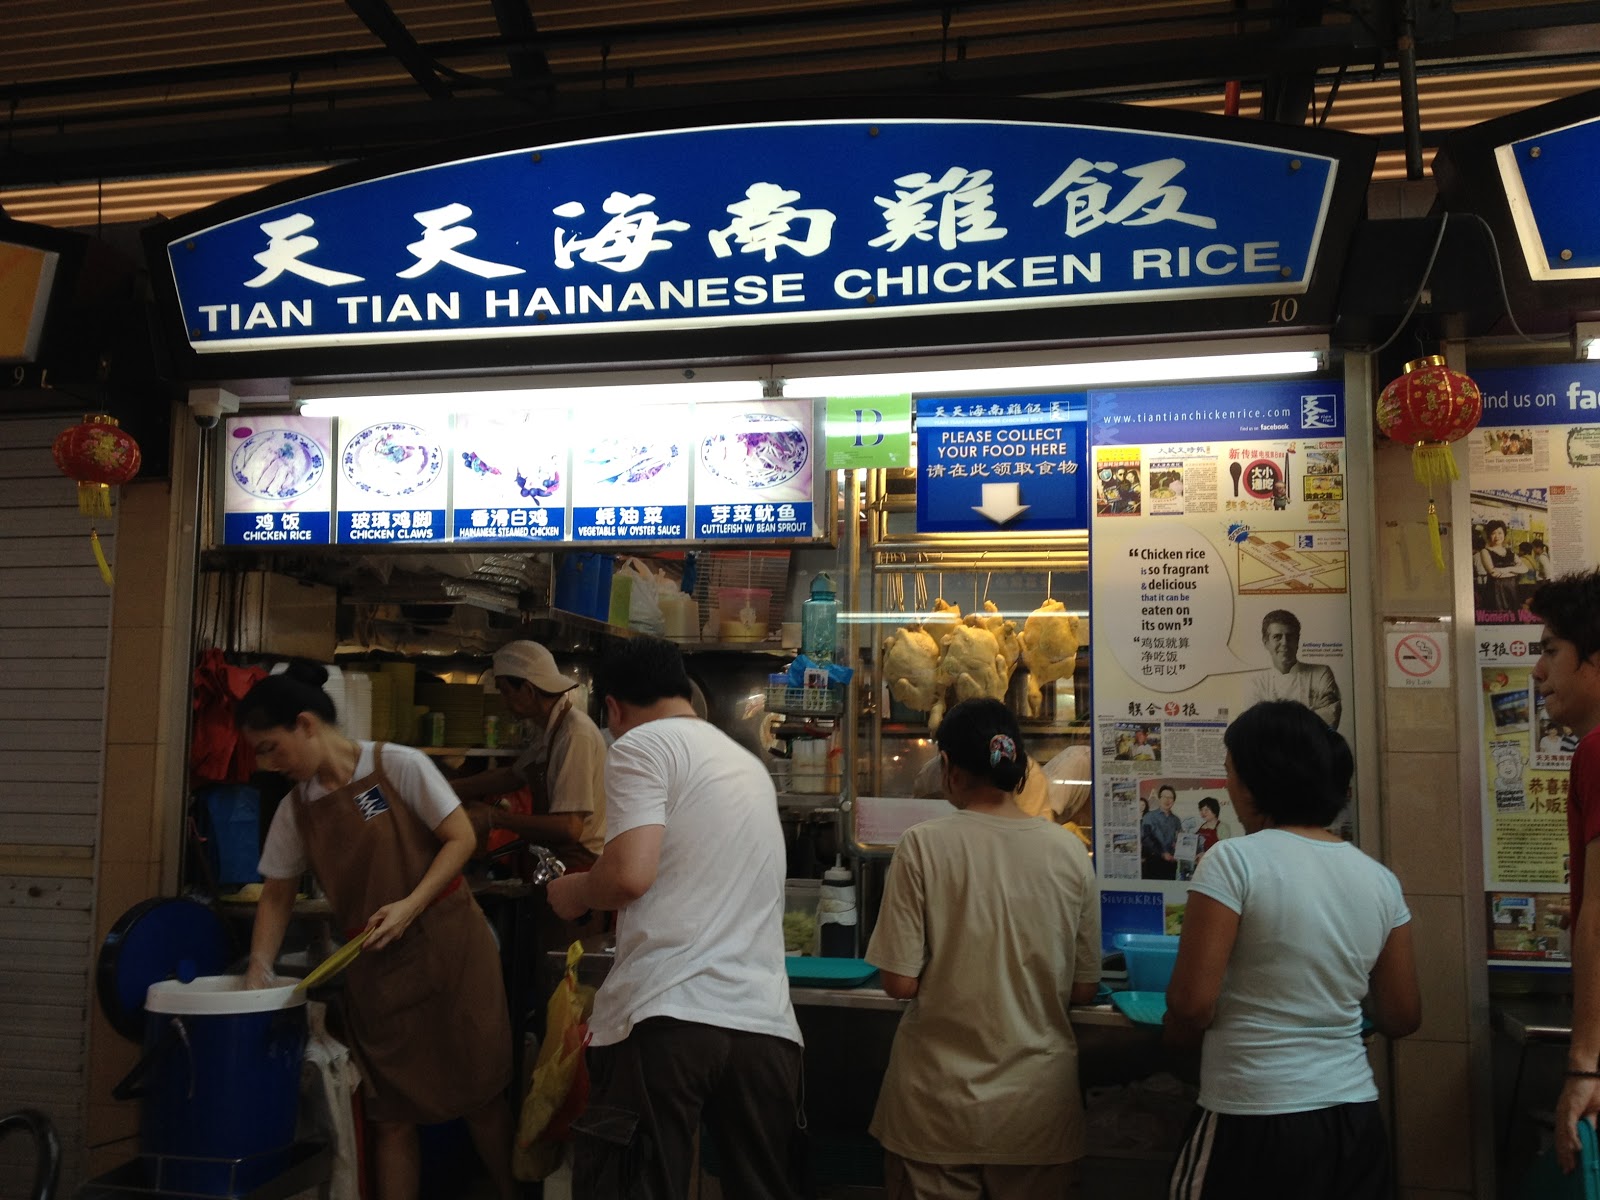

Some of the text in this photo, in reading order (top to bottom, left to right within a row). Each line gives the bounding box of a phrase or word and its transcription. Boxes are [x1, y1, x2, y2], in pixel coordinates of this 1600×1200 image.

[243, 157, 1218, 288] 天天海南雞飯
[198, 240, 1281, 333] TIAN TIAN HAINANESE CHICKEN RICE
[1267, 298, 1298, 323] 10
[14, 366, 25, 385] 9
[1513, 396, 1531, 408] us
[1535, 393, 1556, 407] on
[1566, 381, 1600, 410] fa
[1103, 406, 1291, 424] www.tiantianchickenrice.com
[850, 408, 884, 448] B
[1260, 423, 1289, 431] facebook
[941, 428, 1063, 444] PLEASE COLLECT
[937, 442, 1067, 459] YOUR FOOD HERE
[926, 460, 1078, 478] 请在此领取食物
[1251, 466, 1273, 478] 大小
[255, 512, 301, 531] 鸡饭
[351, 510, 432, 529] 玻璃鸡脚
[471, 508, 549, 527] 香滑白鸡
[595, 507, 663, 526] 蚝油菜
[711, 504, 797, 523] 芽菜鱿鱼
[243, 529, 312, 541] CHICKEN RICE
[349, 528, 433, 540] CHICKEN CLAWS
[459, 526, 559, 537] HAINANESE STEAMED CHICKEN
[578, 525, 681, 537] VEGETABLE W/ OYSTER SAUCE
[701, 522, 806, 534] CUTTLEFISH W/ BEAN SPROUT
[1228, 525, 1250, 541] Branch
[1185, 549, 1206, 559] rice
[1148, 566, 1160, 575] so
[1162, 563, 1209, 577] fragrant
[1148, 579, 1197, 590] delicious
[1141, 606, 1190, 615] eaten on
[1476, 609, 1515, 622] Women's
[1142, 620, 1155, 631] its
[1406, 678, 1415, 686] By
